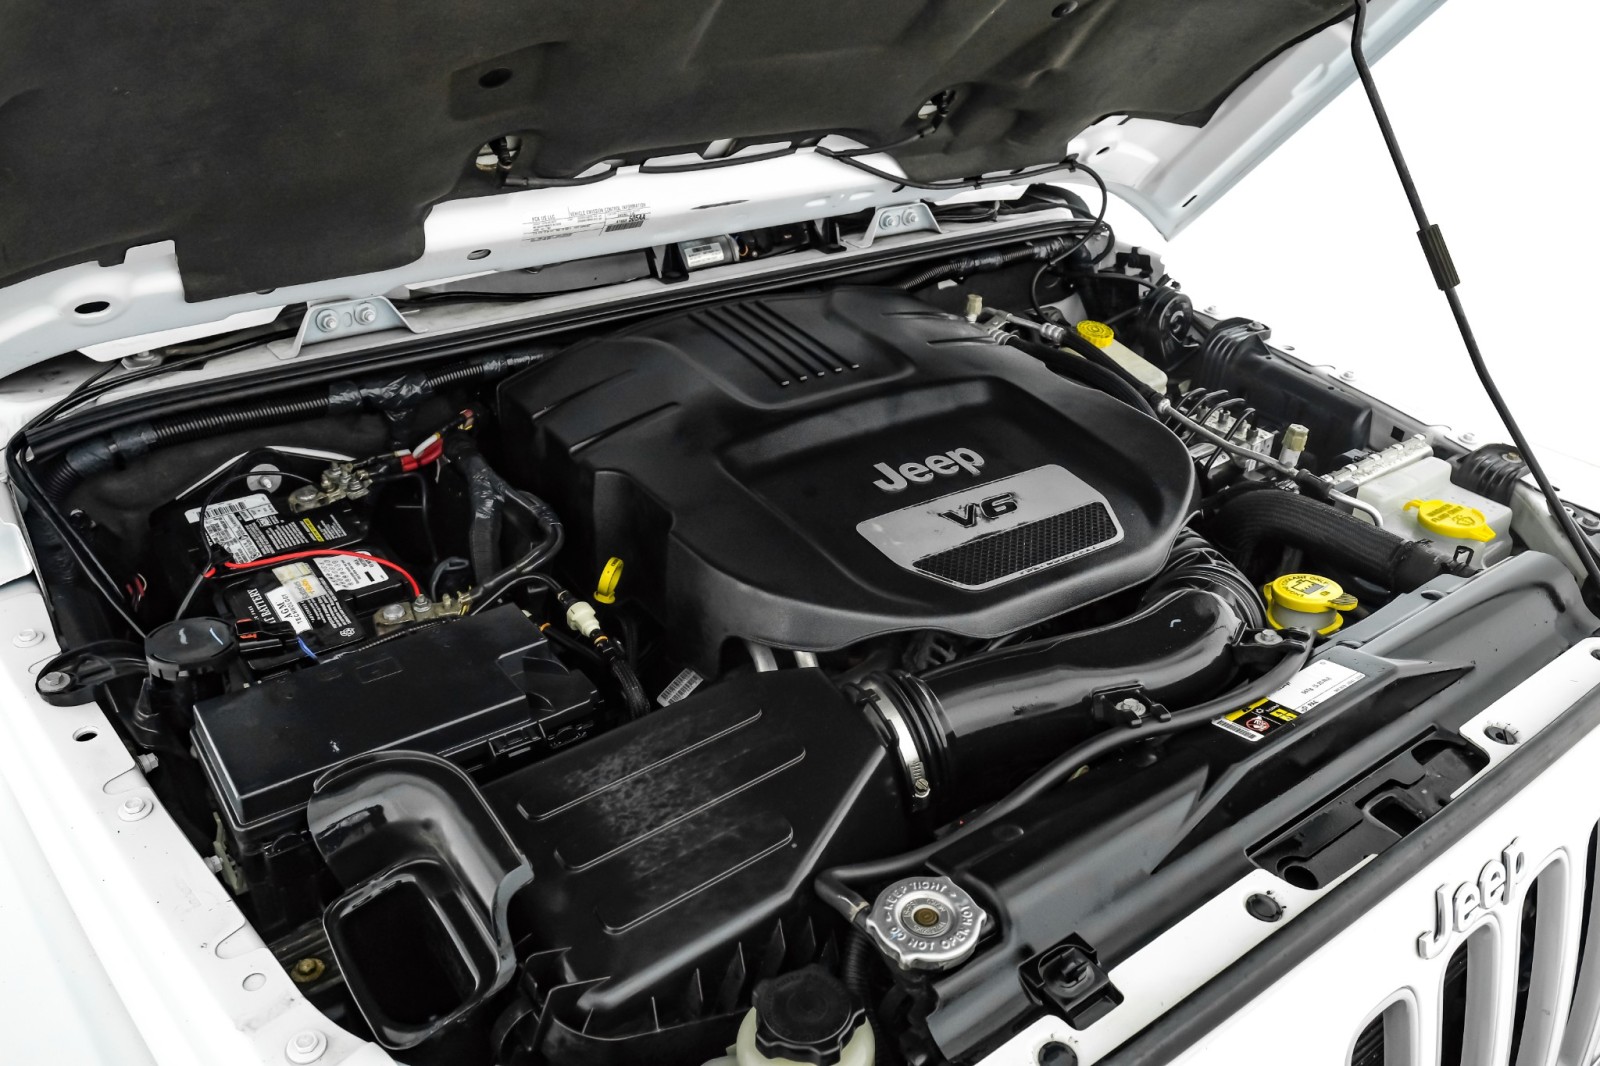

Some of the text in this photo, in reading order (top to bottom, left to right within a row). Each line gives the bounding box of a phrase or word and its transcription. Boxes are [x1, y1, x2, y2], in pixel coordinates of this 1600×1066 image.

[872, 447, 985, 492] Jeep
[937, 492, 1019, 528] V6
[247, 588, 272, 619] BATTERY
[278, 602, 293, 619] AGM
[281, 594, 303, 625] TECHNOLOGY
[1416, 836, 1528, 960] Jeep
